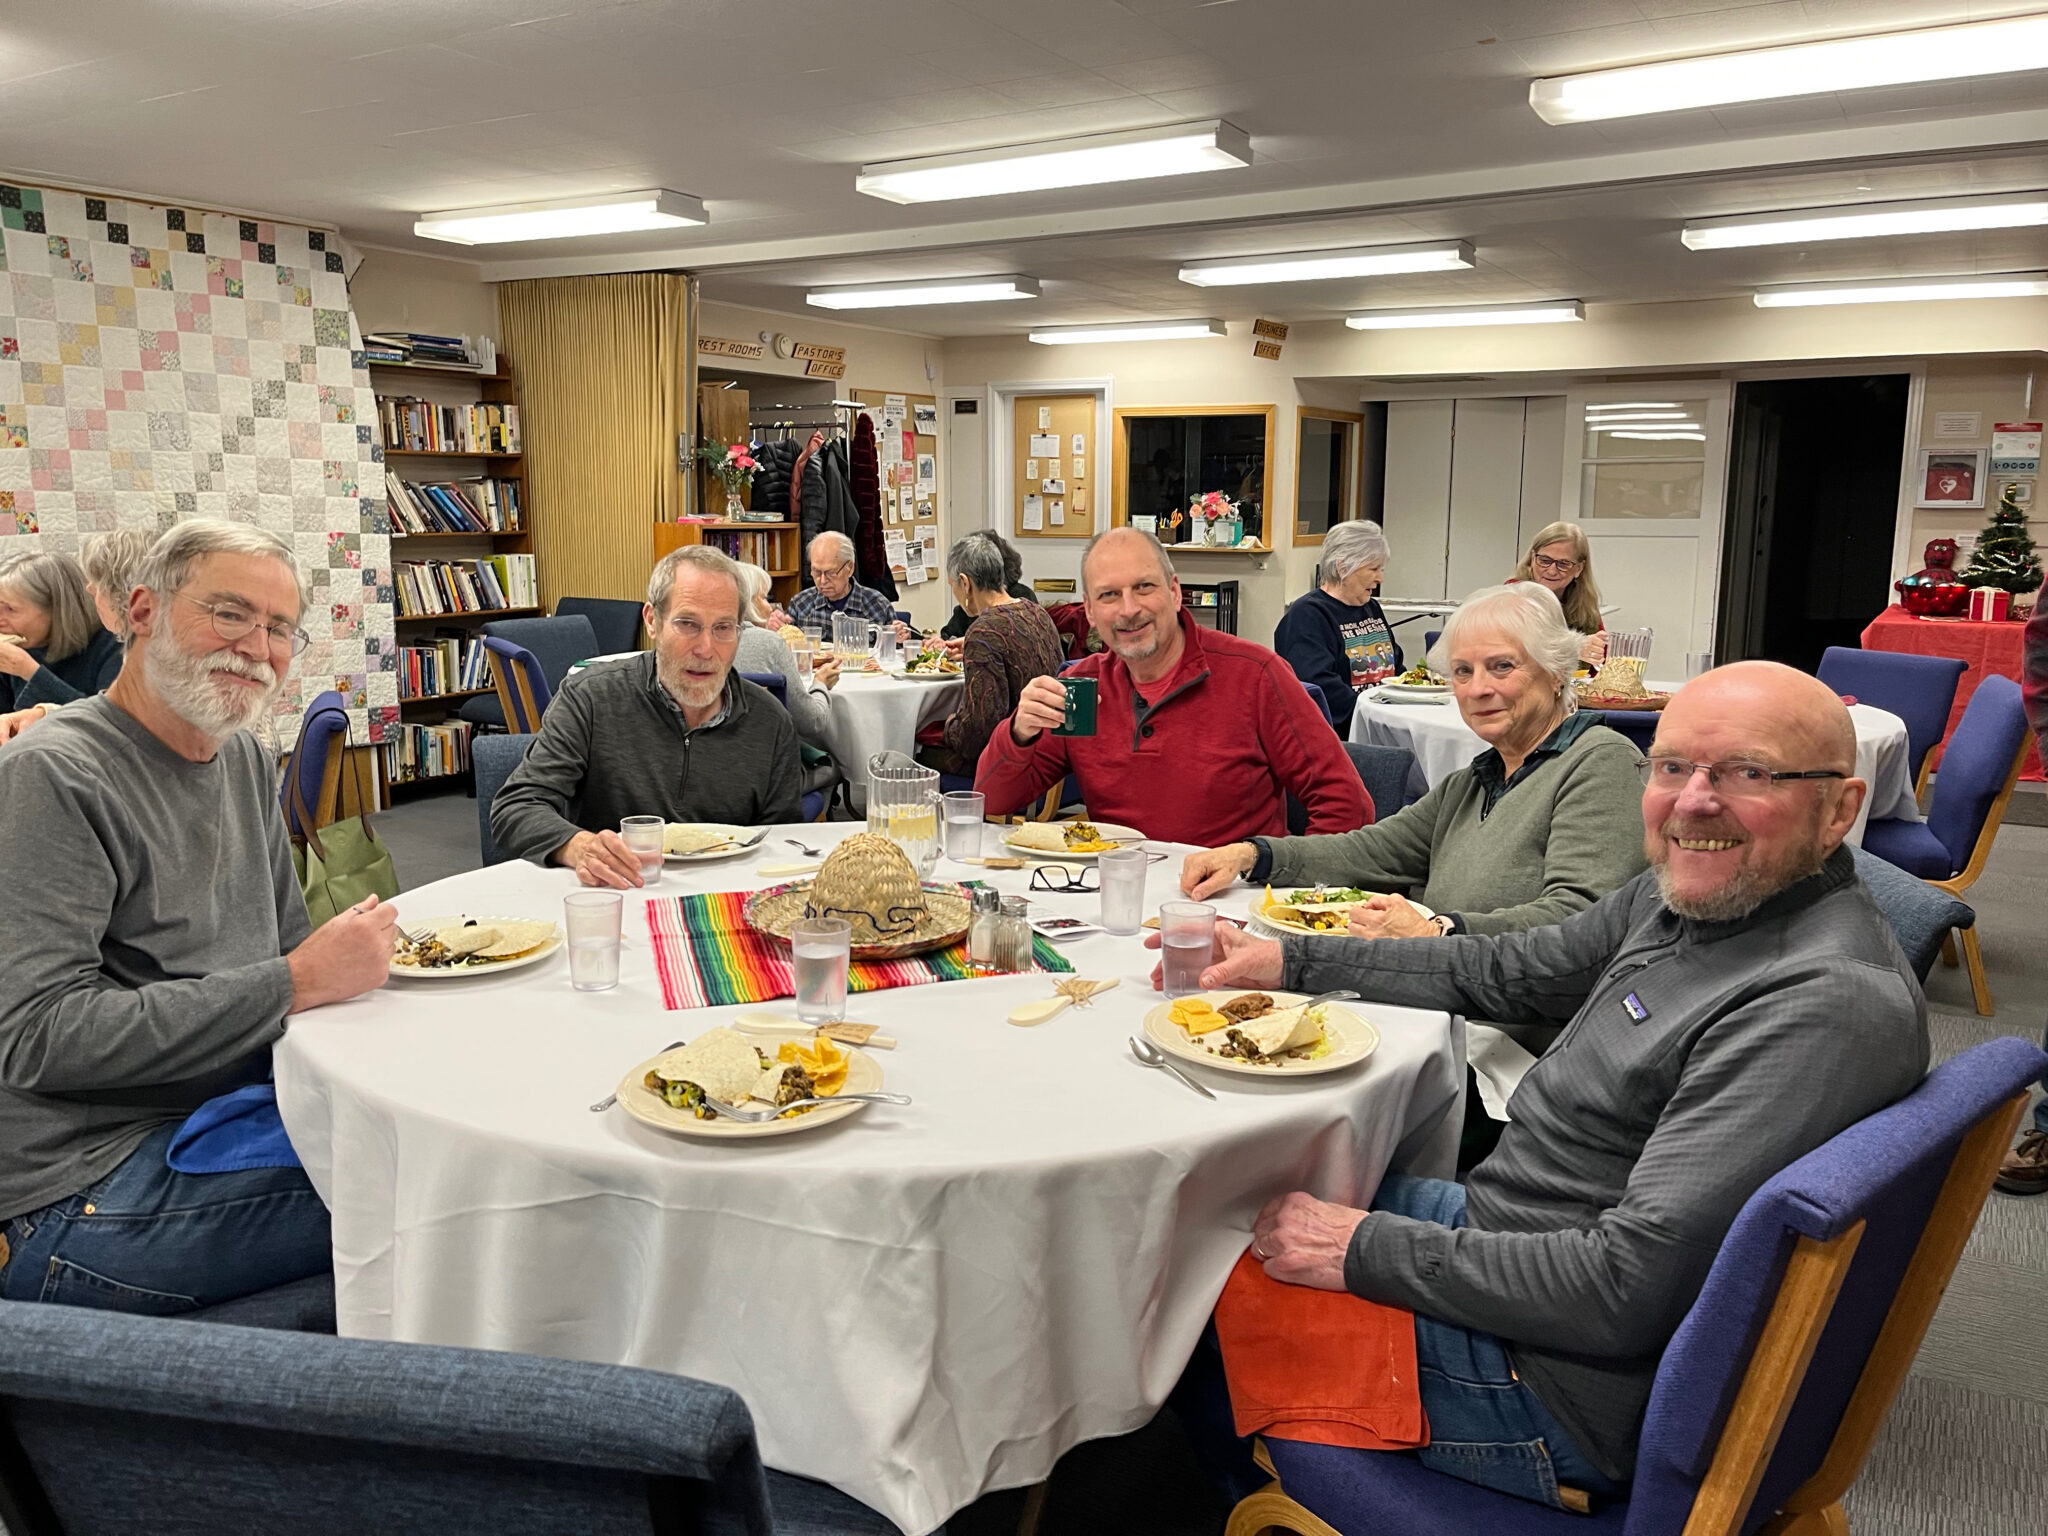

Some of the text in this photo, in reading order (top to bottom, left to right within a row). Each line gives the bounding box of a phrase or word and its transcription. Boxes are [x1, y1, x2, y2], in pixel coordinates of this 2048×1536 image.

[1257, 322, 1287, 338] BUSINESS
[698, 339, 763, 357] REST ROOMS
[796, 346, 843, 361] PASTOR'S
[1258, 344, 1281, 358] OFFICE
[811, 363, 843, 376] OFFICE
